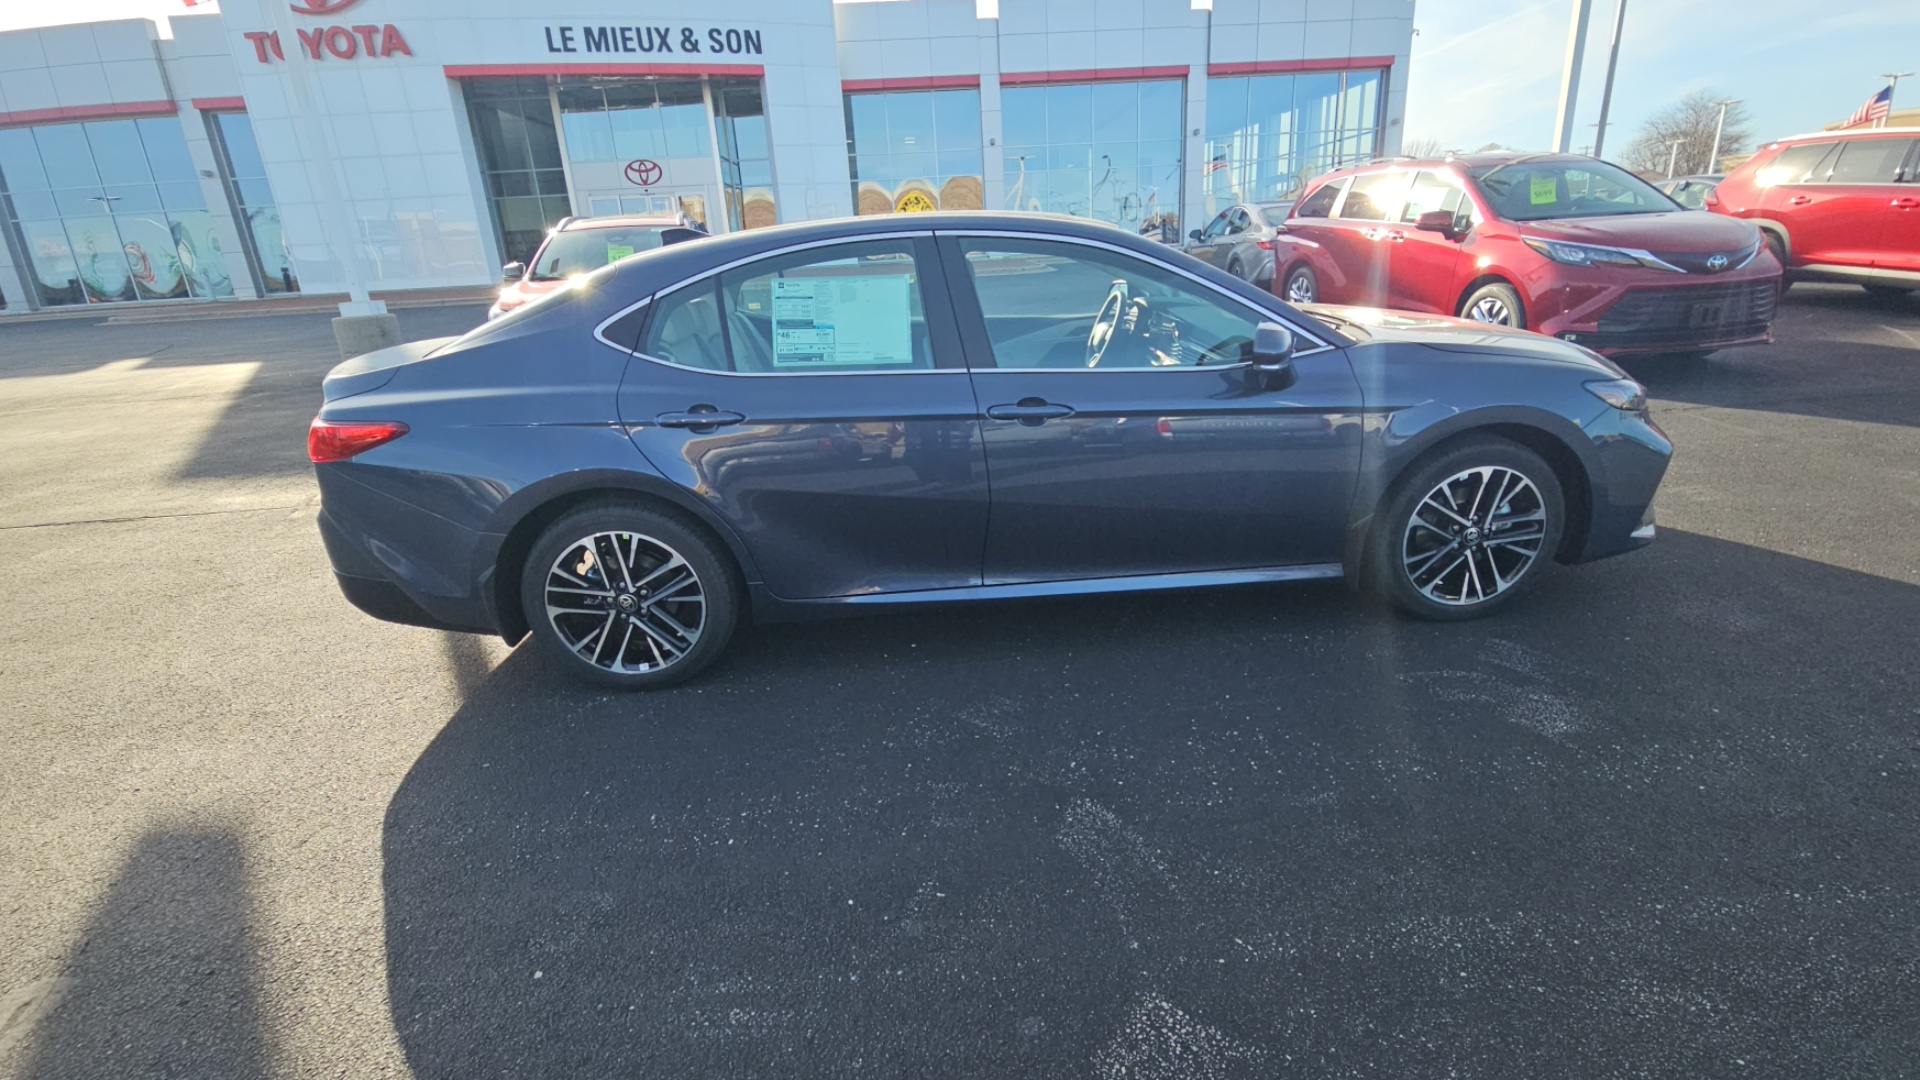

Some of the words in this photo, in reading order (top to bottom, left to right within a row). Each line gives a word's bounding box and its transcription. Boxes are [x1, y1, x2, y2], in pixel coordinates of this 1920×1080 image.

[545, 27, 577, 53] LE
[583, 27, 674, 53] MIEUX
[680, 27, 702, 54] &
[708, 28, 763, 55] SON
